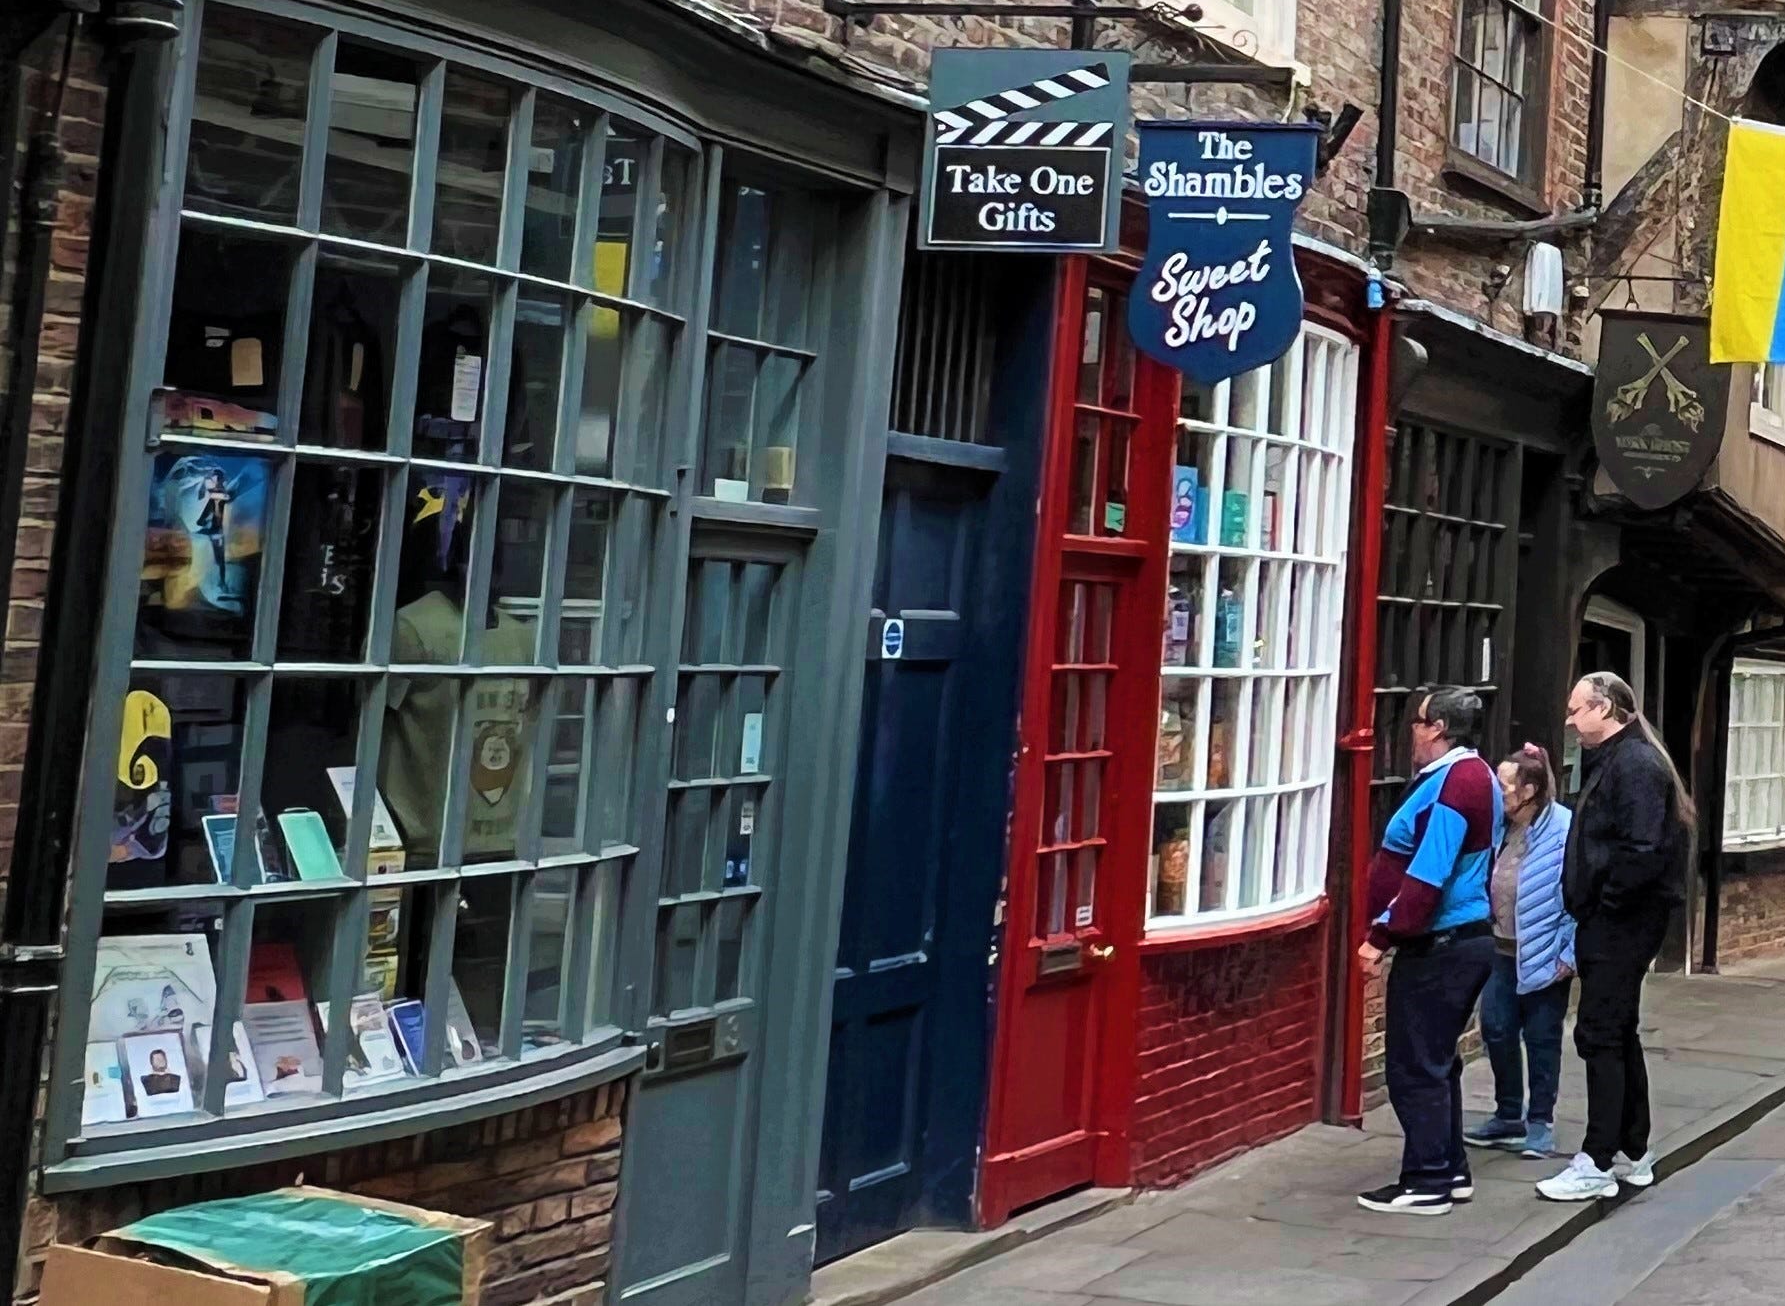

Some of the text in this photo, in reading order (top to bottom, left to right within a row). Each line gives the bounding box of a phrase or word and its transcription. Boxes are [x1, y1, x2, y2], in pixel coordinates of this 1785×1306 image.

[1198, 131, 1253, 160] The
[945, 164, 1095, 196] Take One
[1144, 161, 1303, 201] Shambles
[978, 202, 1056, 233] Gifts
[1151, 239, 1272, 302] Sweet
[1164, 294, 1256, 352] Shop
